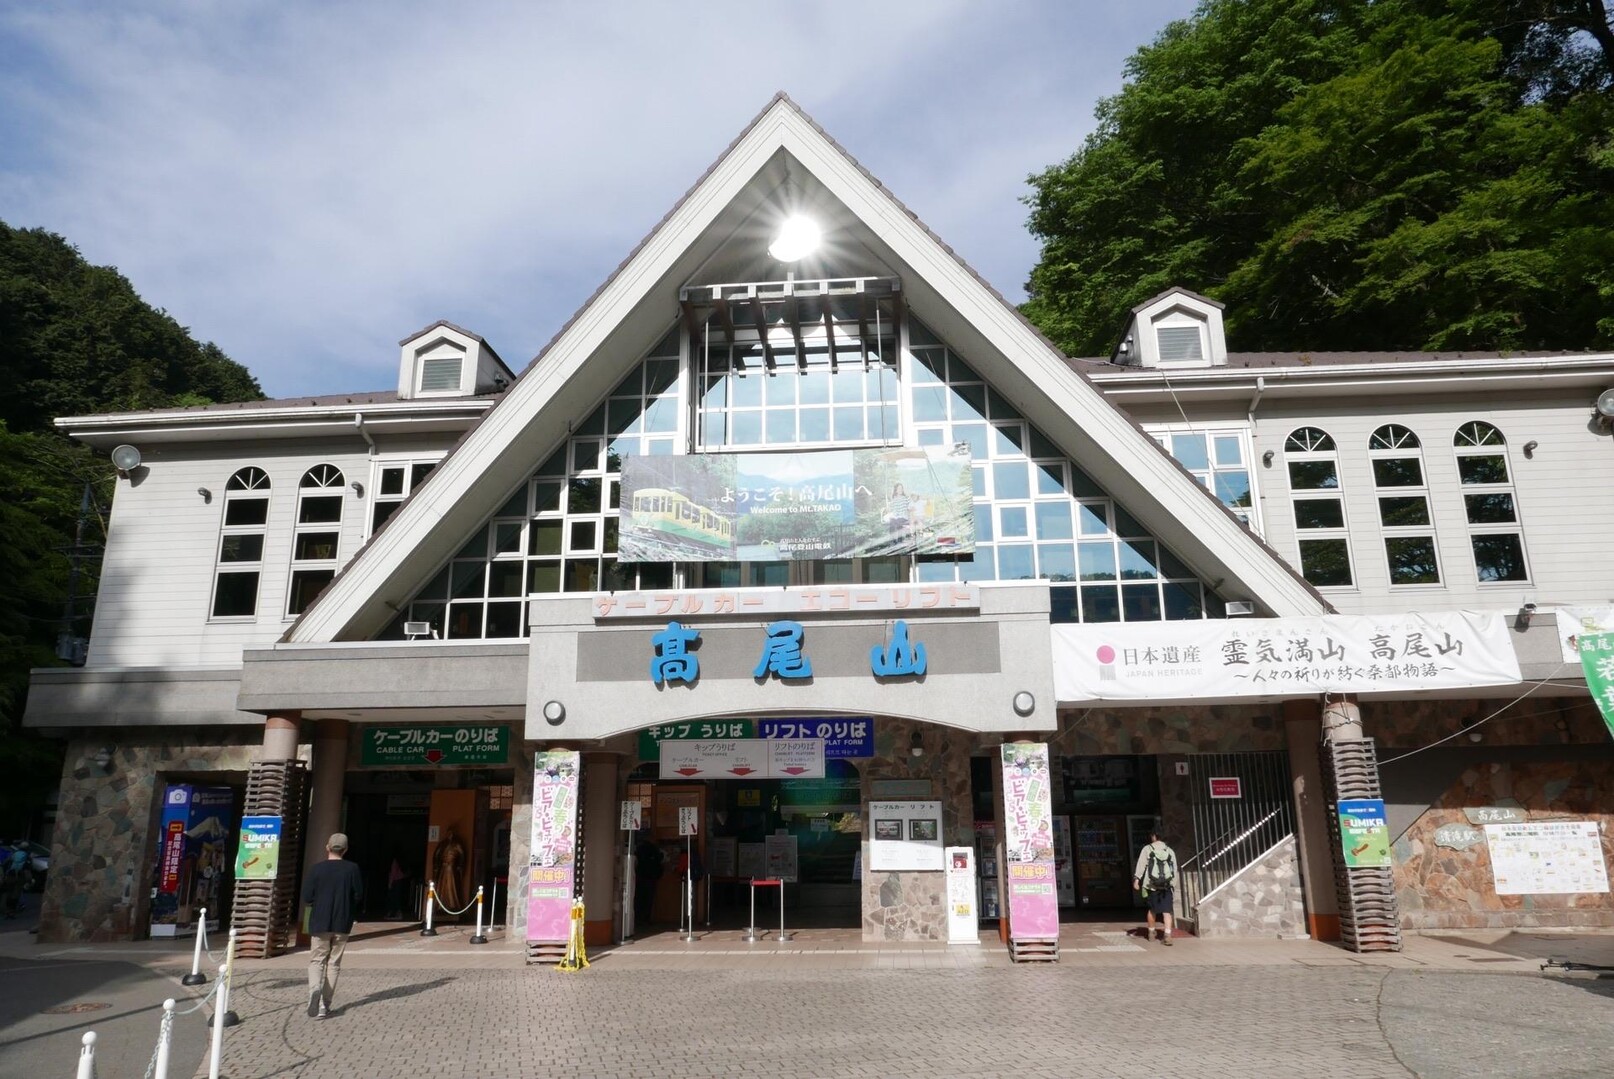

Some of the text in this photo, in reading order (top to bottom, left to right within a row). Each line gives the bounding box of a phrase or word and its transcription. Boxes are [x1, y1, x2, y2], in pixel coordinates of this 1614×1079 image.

[720, 483, 873, 503] ようこそ！高尾山へ
[751, 504, 842, 515] Welcome to Mt.TAKAO
[595, 593, 765, 616] ケーブルカー
[1221, 632, 1463, 666] 霊気満山 高尾山
[1581, 638, 1614, 652] 高尾
[1124, 645, 1201, 666] 日本遺産
[1126, 668, 1203, 678] JAPAN HERITAGE
[374, 728, 499, 744] ケーブルカーのりば
[694, 742, 736, 752] キップうりば
[774, 742, 815, 751] リフトのりば
[1478, 809, 1516, 821] 高尾山
[1343, 818, 1384, 827] SUMIKA
[242, 833, 278, 842] SUMIKA
